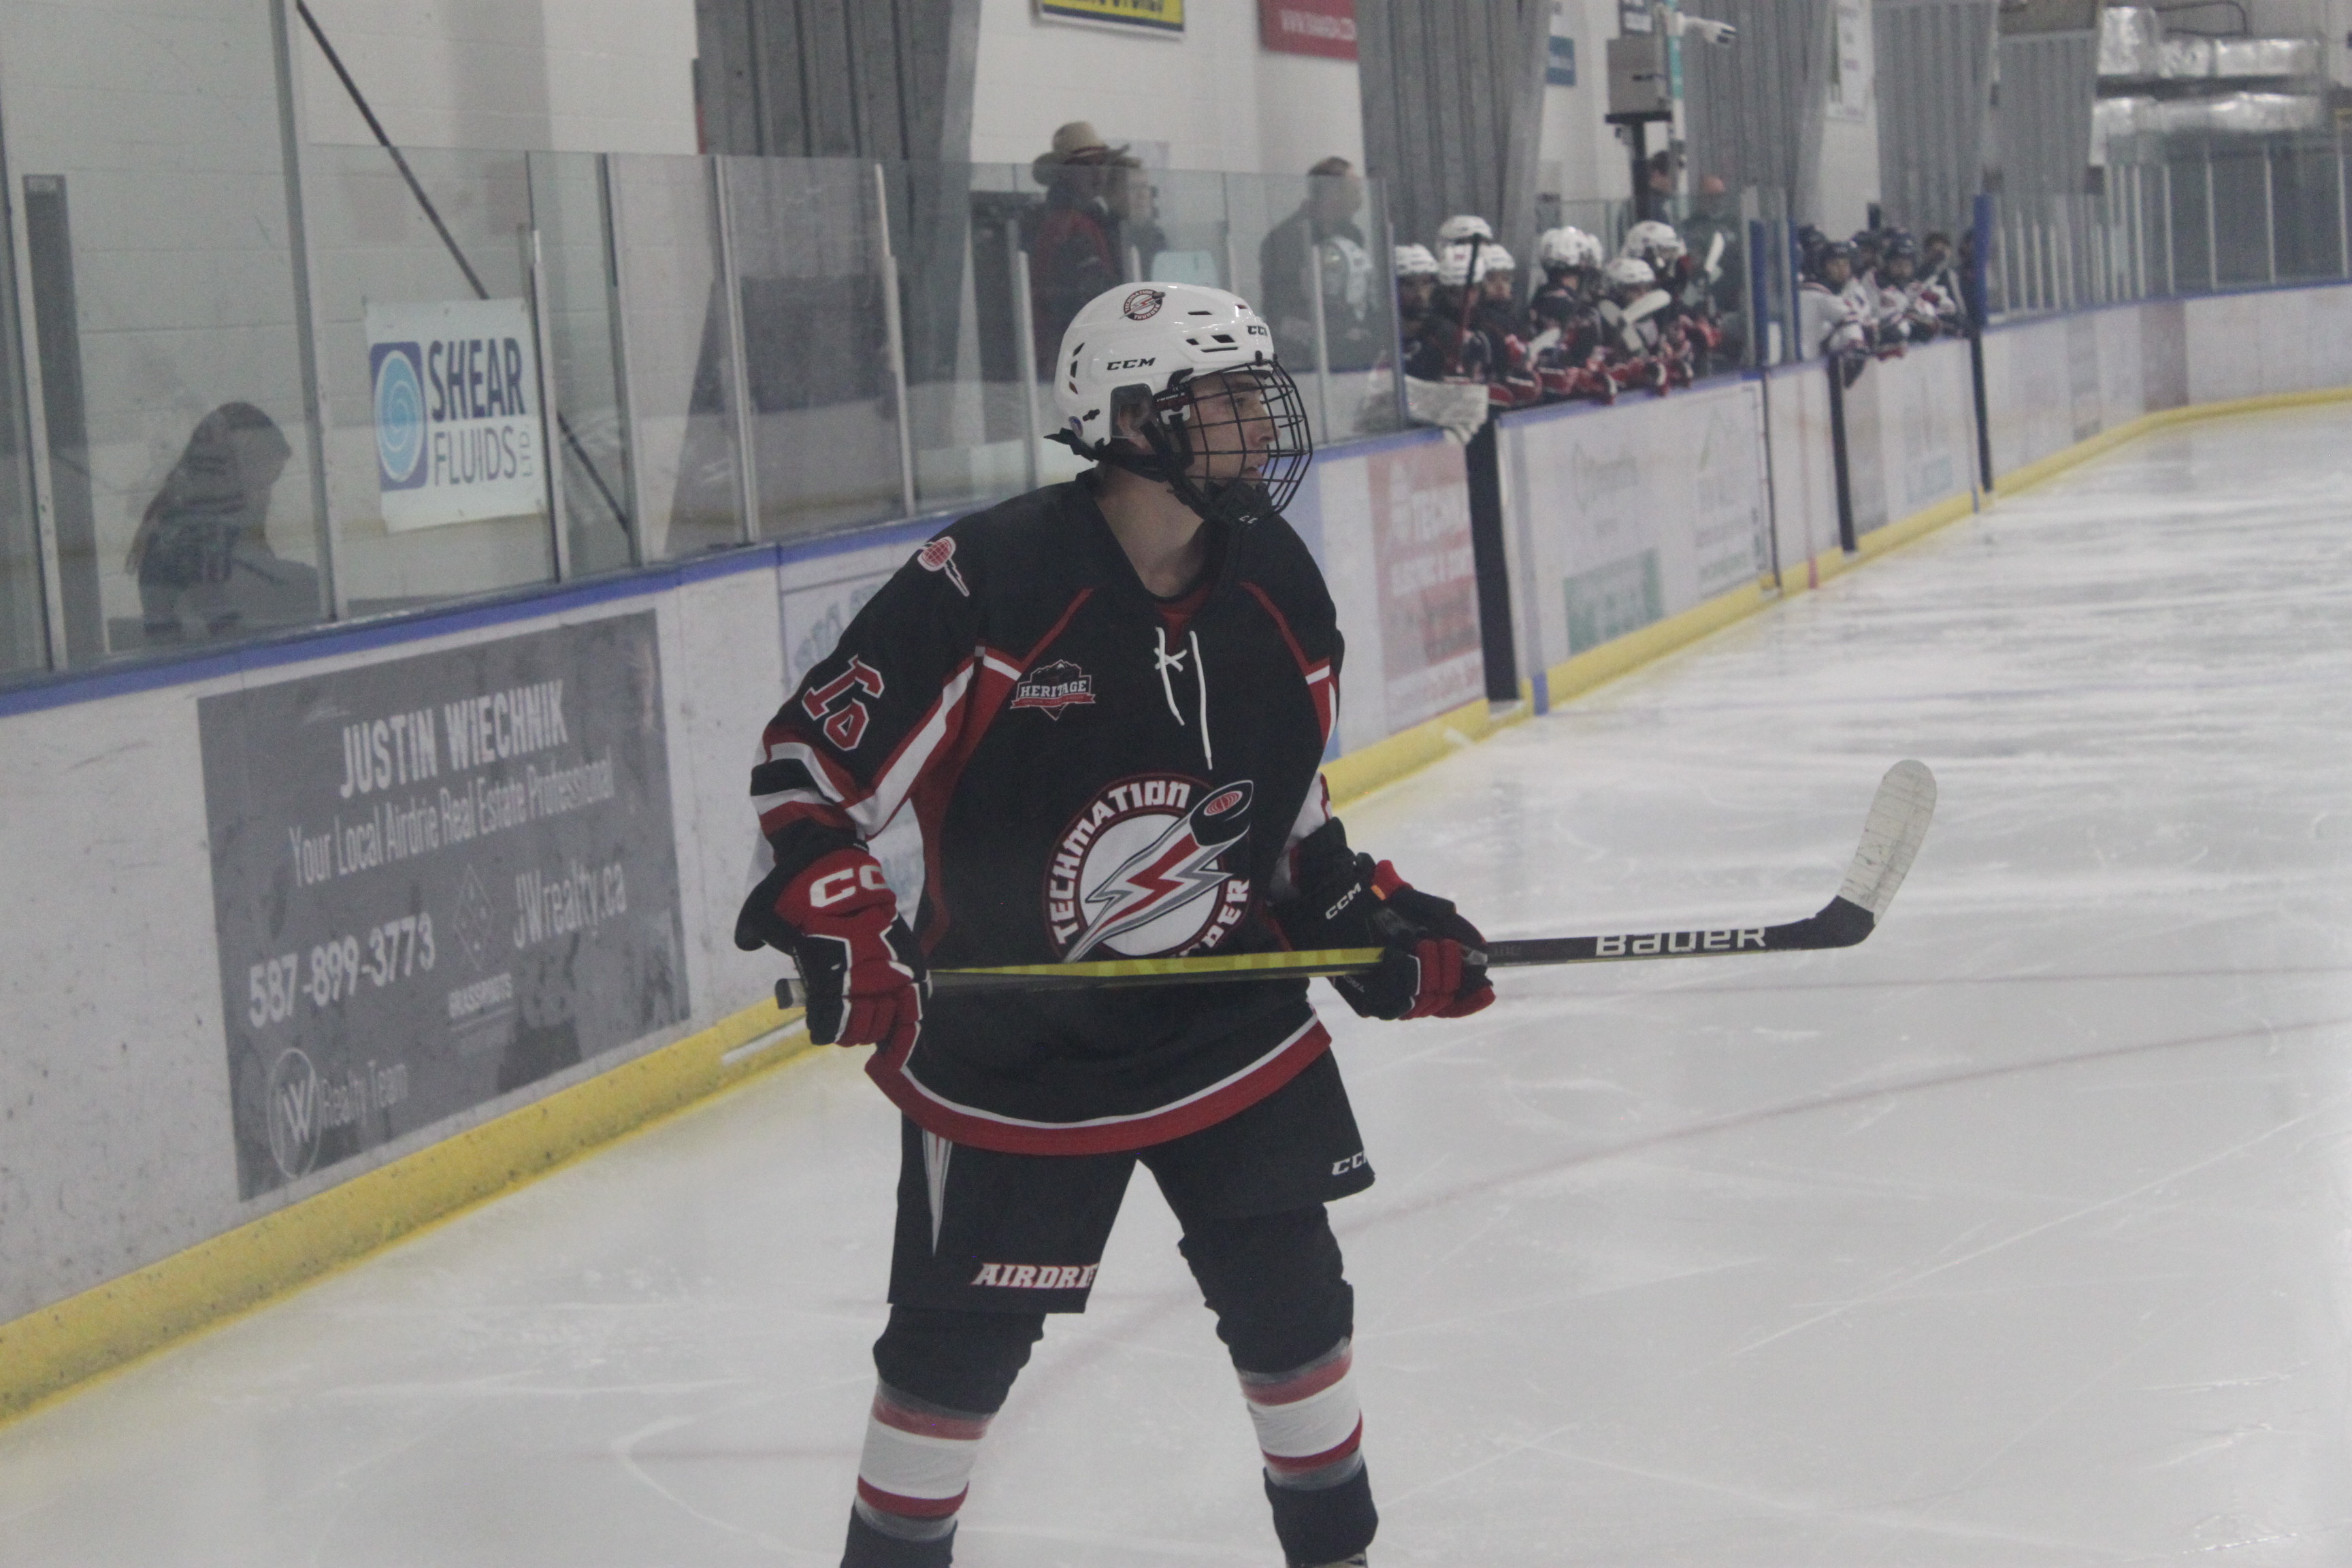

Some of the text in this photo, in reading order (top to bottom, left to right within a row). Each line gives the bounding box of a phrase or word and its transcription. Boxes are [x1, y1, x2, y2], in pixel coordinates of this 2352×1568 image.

[428, 338, 525, 422] SHEAR
[1106, 357, 1156, 370] CCM
[434, 425, 517, 486] FLUIDS
[1021, 680, 1087, 698] HERITAGE
[340, 679, 568, 798] JUSTIN WIECHNIK
[289, 747, 614, 887] Your Local Airdrie Real Estate Professional
[810, 865, 888, 908] CC
[1049, 781, 1191, 945] TECHMATION
[1325, 883, 1362, 919] CCM
[250, 912, 436, 1028] 587-899-3773
[1332, 1151, 1367, 1176] CC
